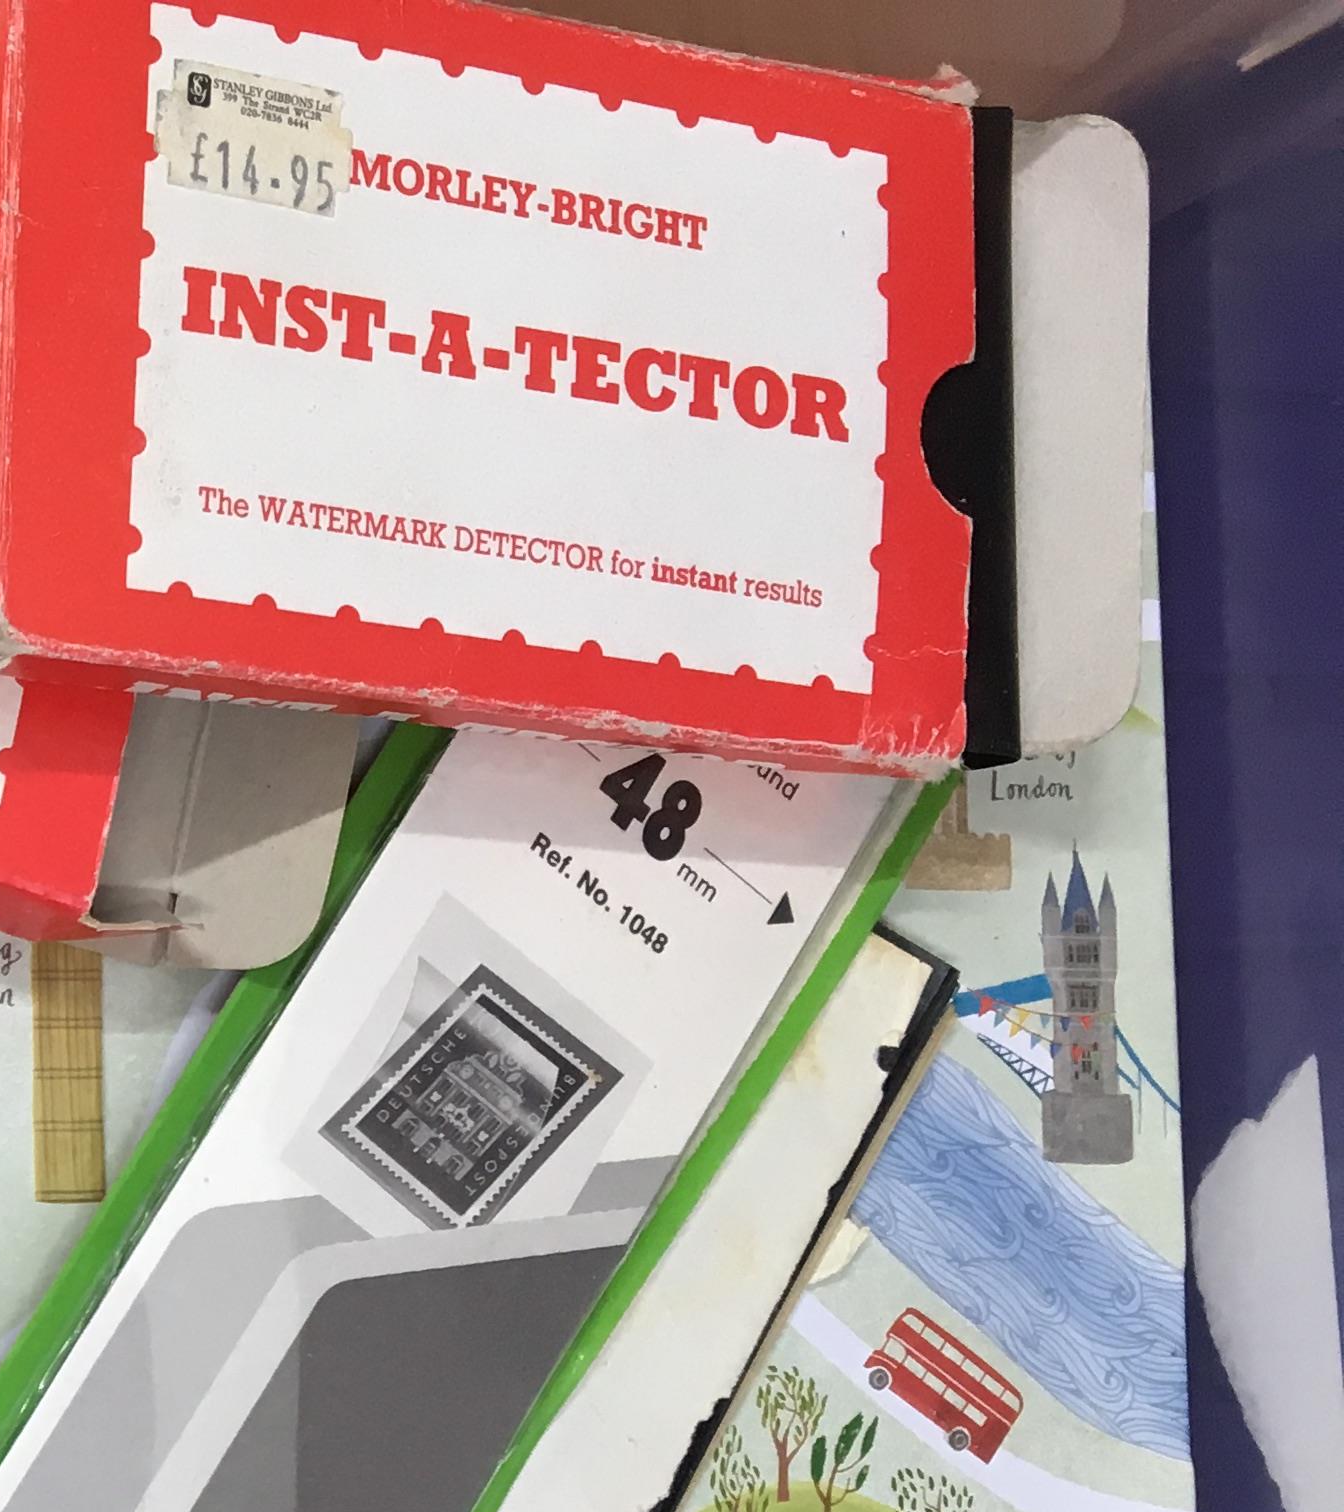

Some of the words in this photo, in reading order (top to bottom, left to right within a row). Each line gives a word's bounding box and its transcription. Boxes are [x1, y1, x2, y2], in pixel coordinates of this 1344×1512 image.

[213, 78, 262, 99] STANLEY
[265, 89, 314, 110] GIBBONS
[243, 95, 259, 108] The
[262, 101, 290, 115] Strand
[351, 149, 707, 252] MORLEY-BRIGHT
[180, 265, 851, 443] INST-A-TECTOR
[199, 484, 250, 519] The
[257, 492, 448, 551] WATERMARK
[454, 524, 604, 573] DETECTOR
[609, 549, 645, 578] for
[651, 554, 738, 596] instant
[742, 564, 823, 608] results
[598, 753, 702, 861] 48
[991, 769, 1074, 801] London
[529, 833, 572, 876] Ref.
[576, 867, 613, 909] No.
[618, 902, 670, 956] 1048
[676, 861, 718, 902] mm
